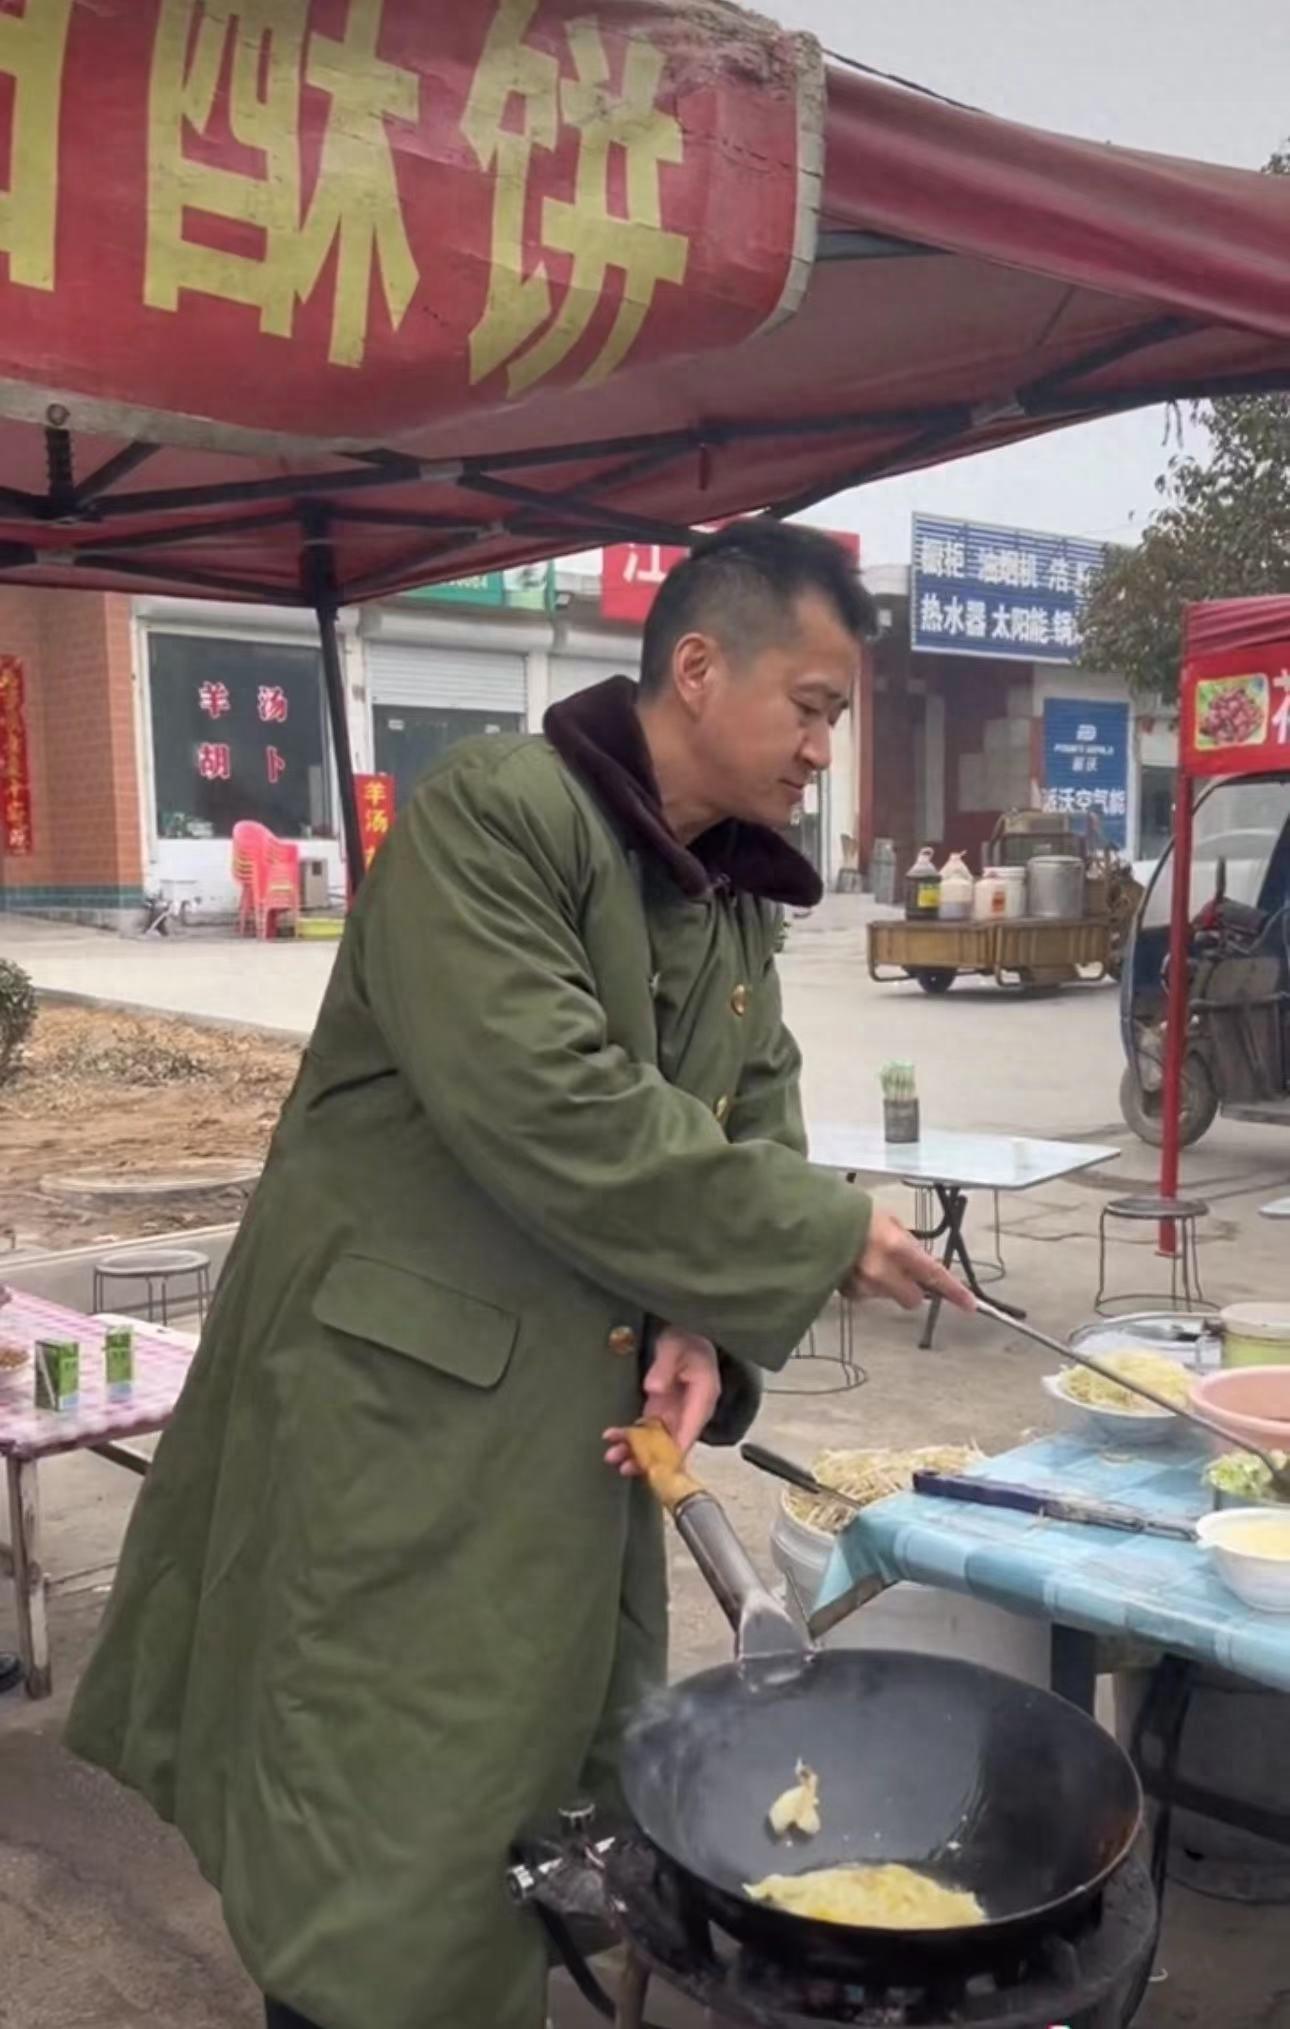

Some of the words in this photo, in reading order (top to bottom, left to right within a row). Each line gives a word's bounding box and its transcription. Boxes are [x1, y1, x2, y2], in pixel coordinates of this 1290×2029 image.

[921, 592, 986, 638] 热水器
[991, 603, 1049, 645] 太阳能
[198, 680, 289, 723] 羊汤
